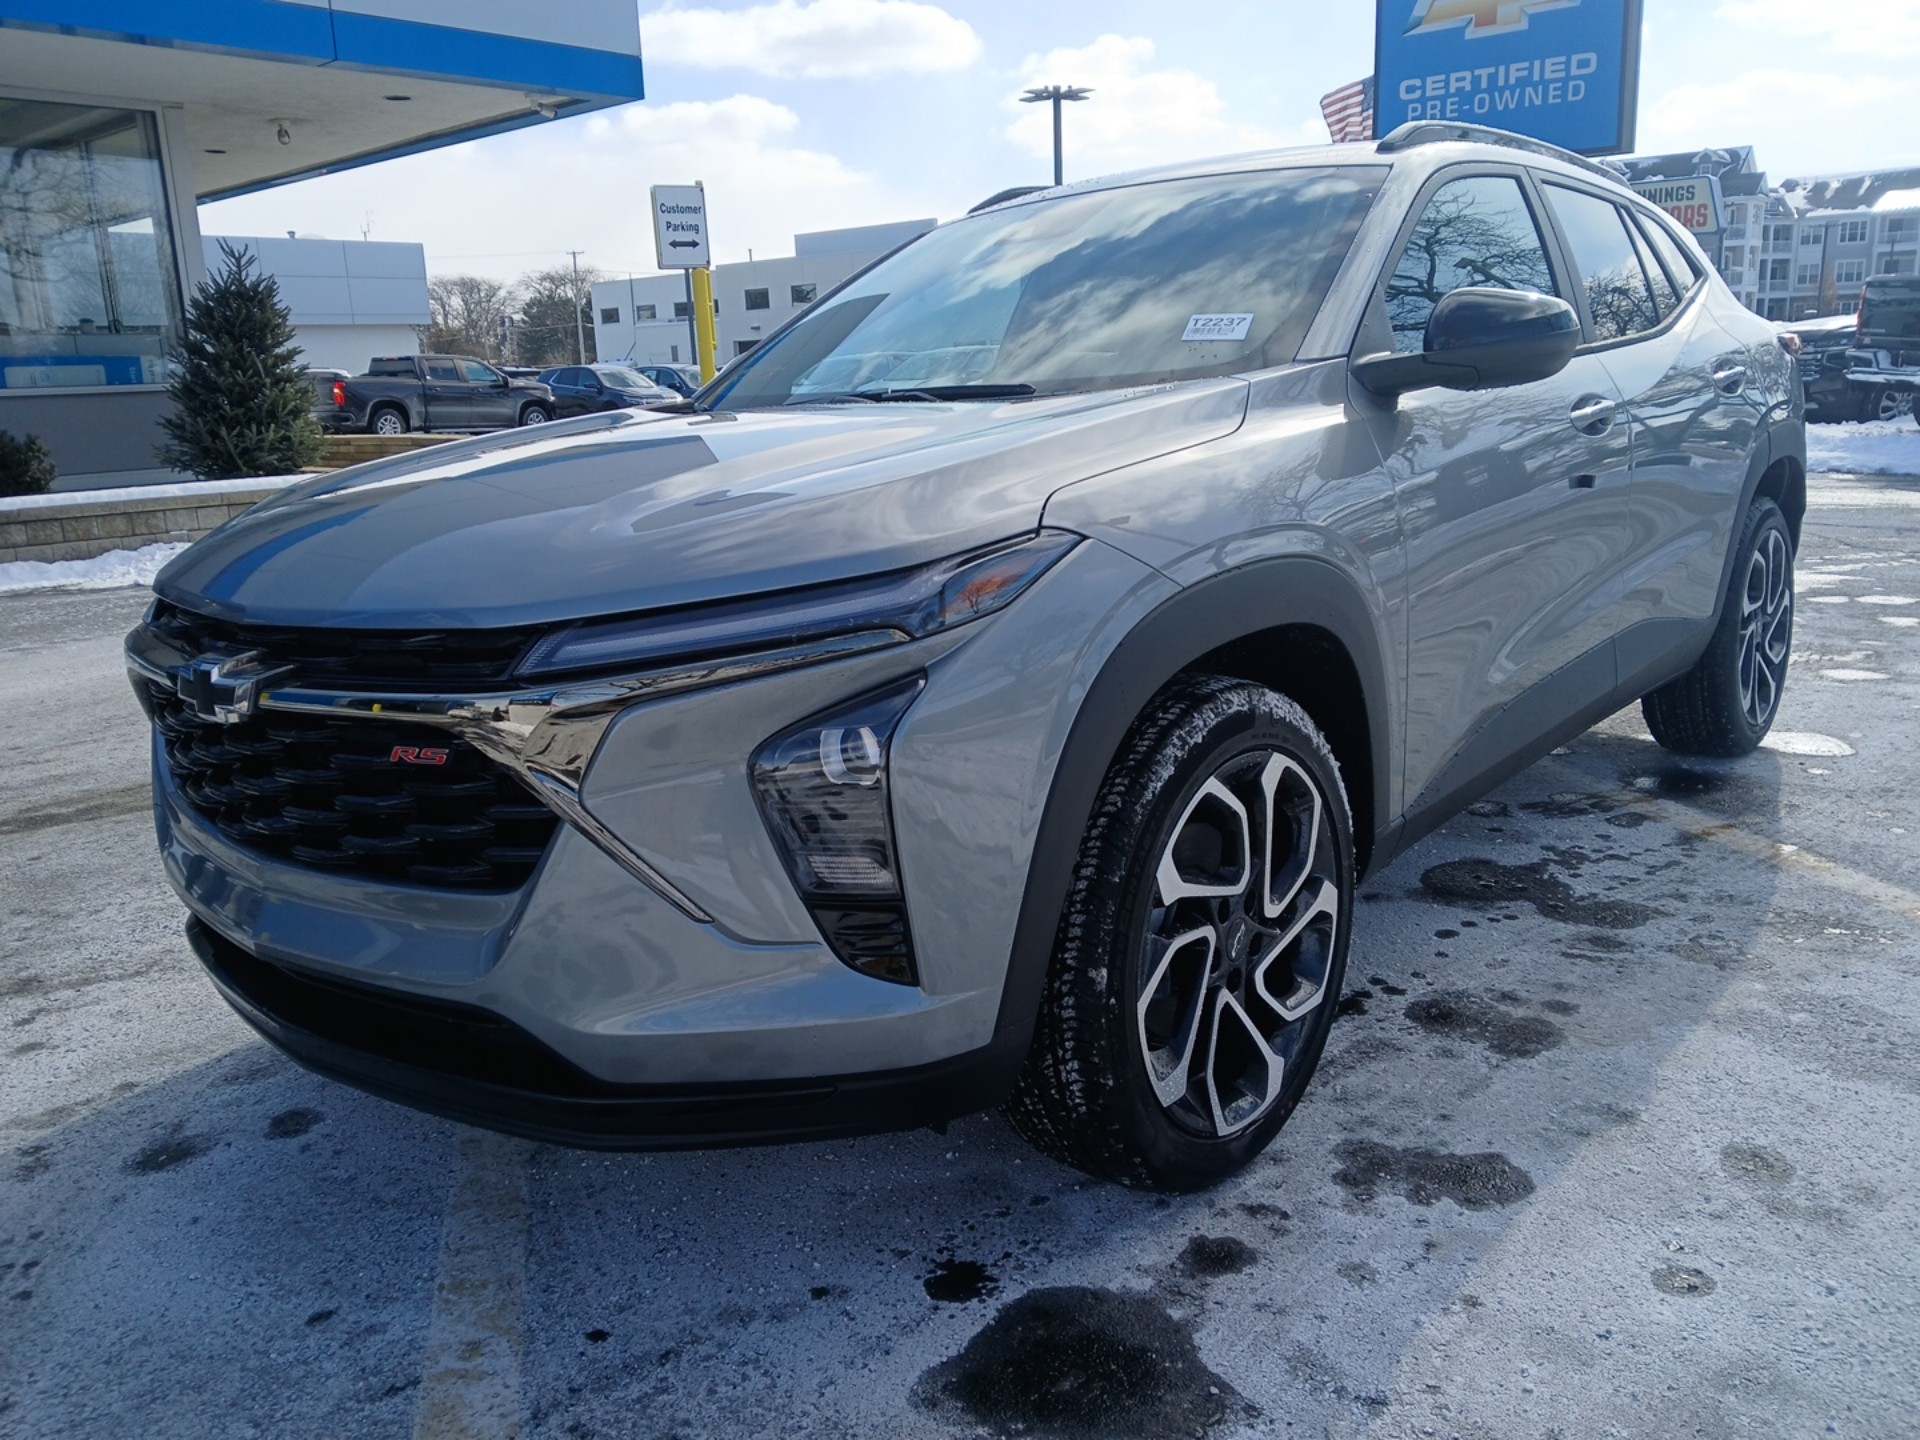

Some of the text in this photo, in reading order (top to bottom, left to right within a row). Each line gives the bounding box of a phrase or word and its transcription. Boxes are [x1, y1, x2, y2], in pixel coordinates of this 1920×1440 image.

[1400, 52, 1598, 101] CERTIFIED
[1407, 79, 1585, 121] PRE-OWNED
[659, 202, 702, 215] Customer
[1664, 203, 1708, 228] ORS
[665, 220, 700, 235] Parking
[1192, 316, 1247, 328] T2237
[389, 745, 449, 765] RS
